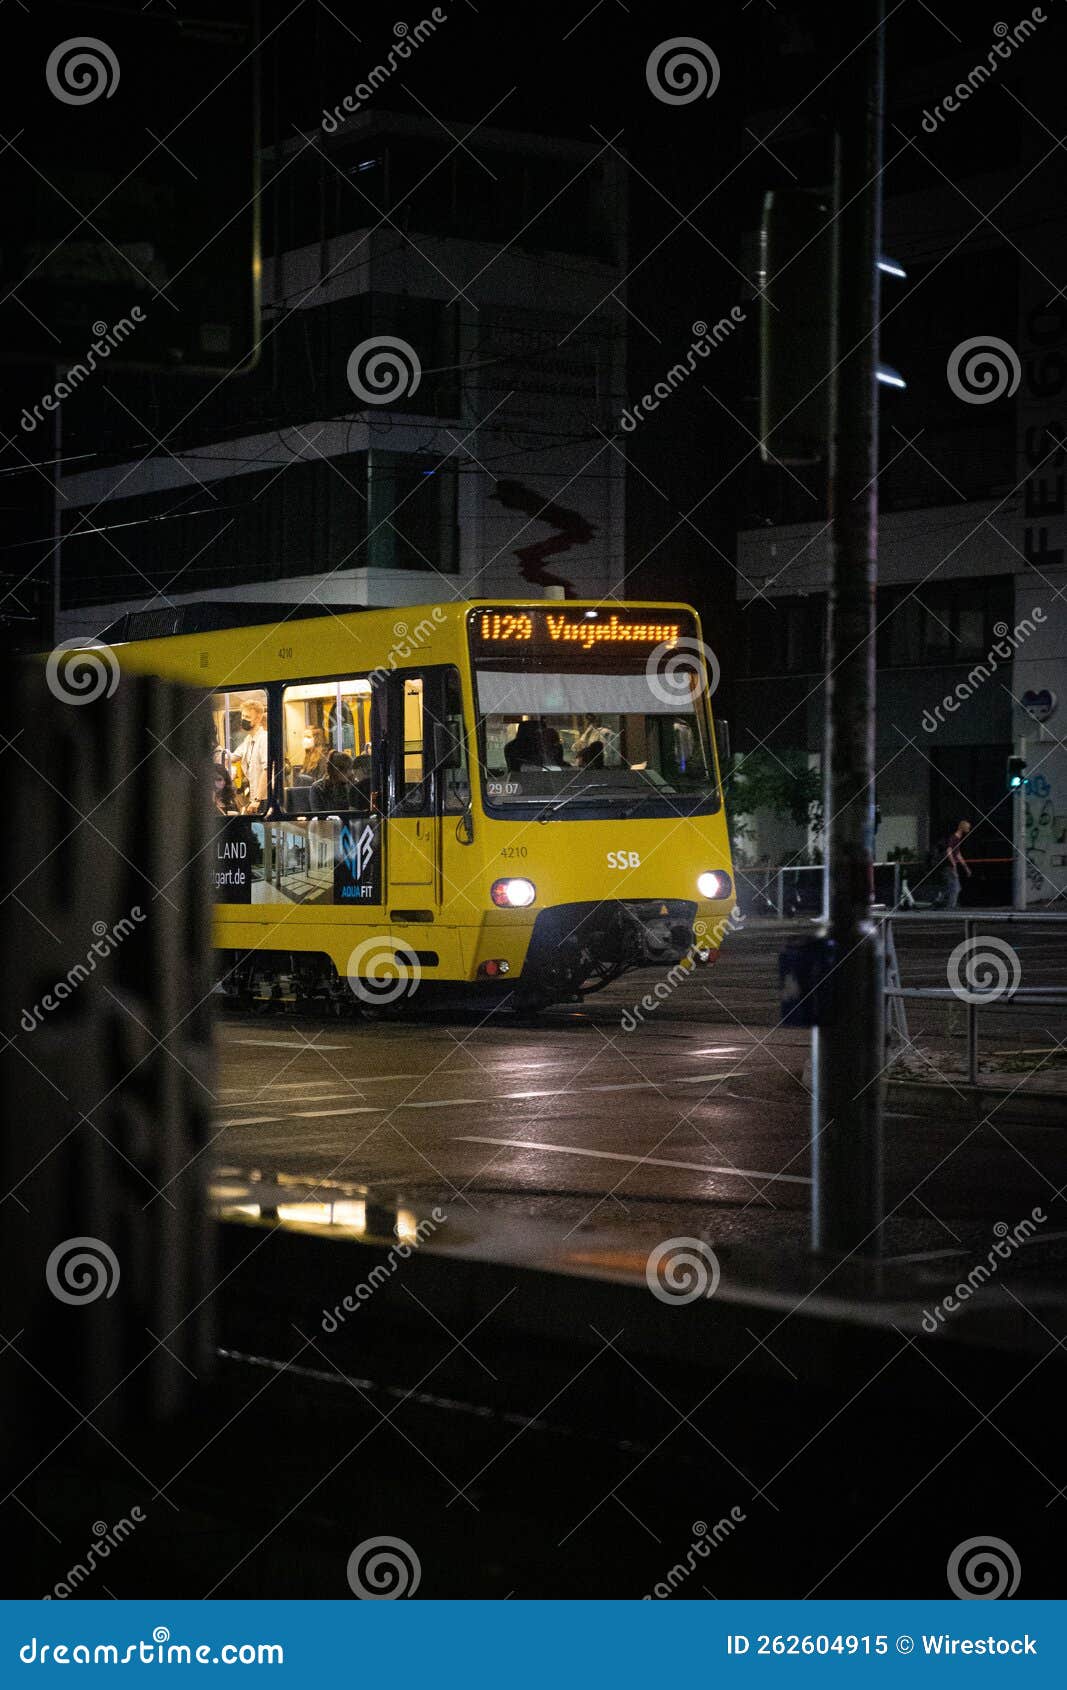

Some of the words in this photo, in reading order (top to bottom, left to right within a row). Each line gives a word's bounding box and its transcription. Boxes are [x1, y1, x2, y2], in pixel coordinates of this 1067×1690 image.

[482, 614, 533, 639] U29
[217, 841, 247, 859] LAND
[500, 846, 528, 859] 4210
[606, 849, 641, 870] SSB
